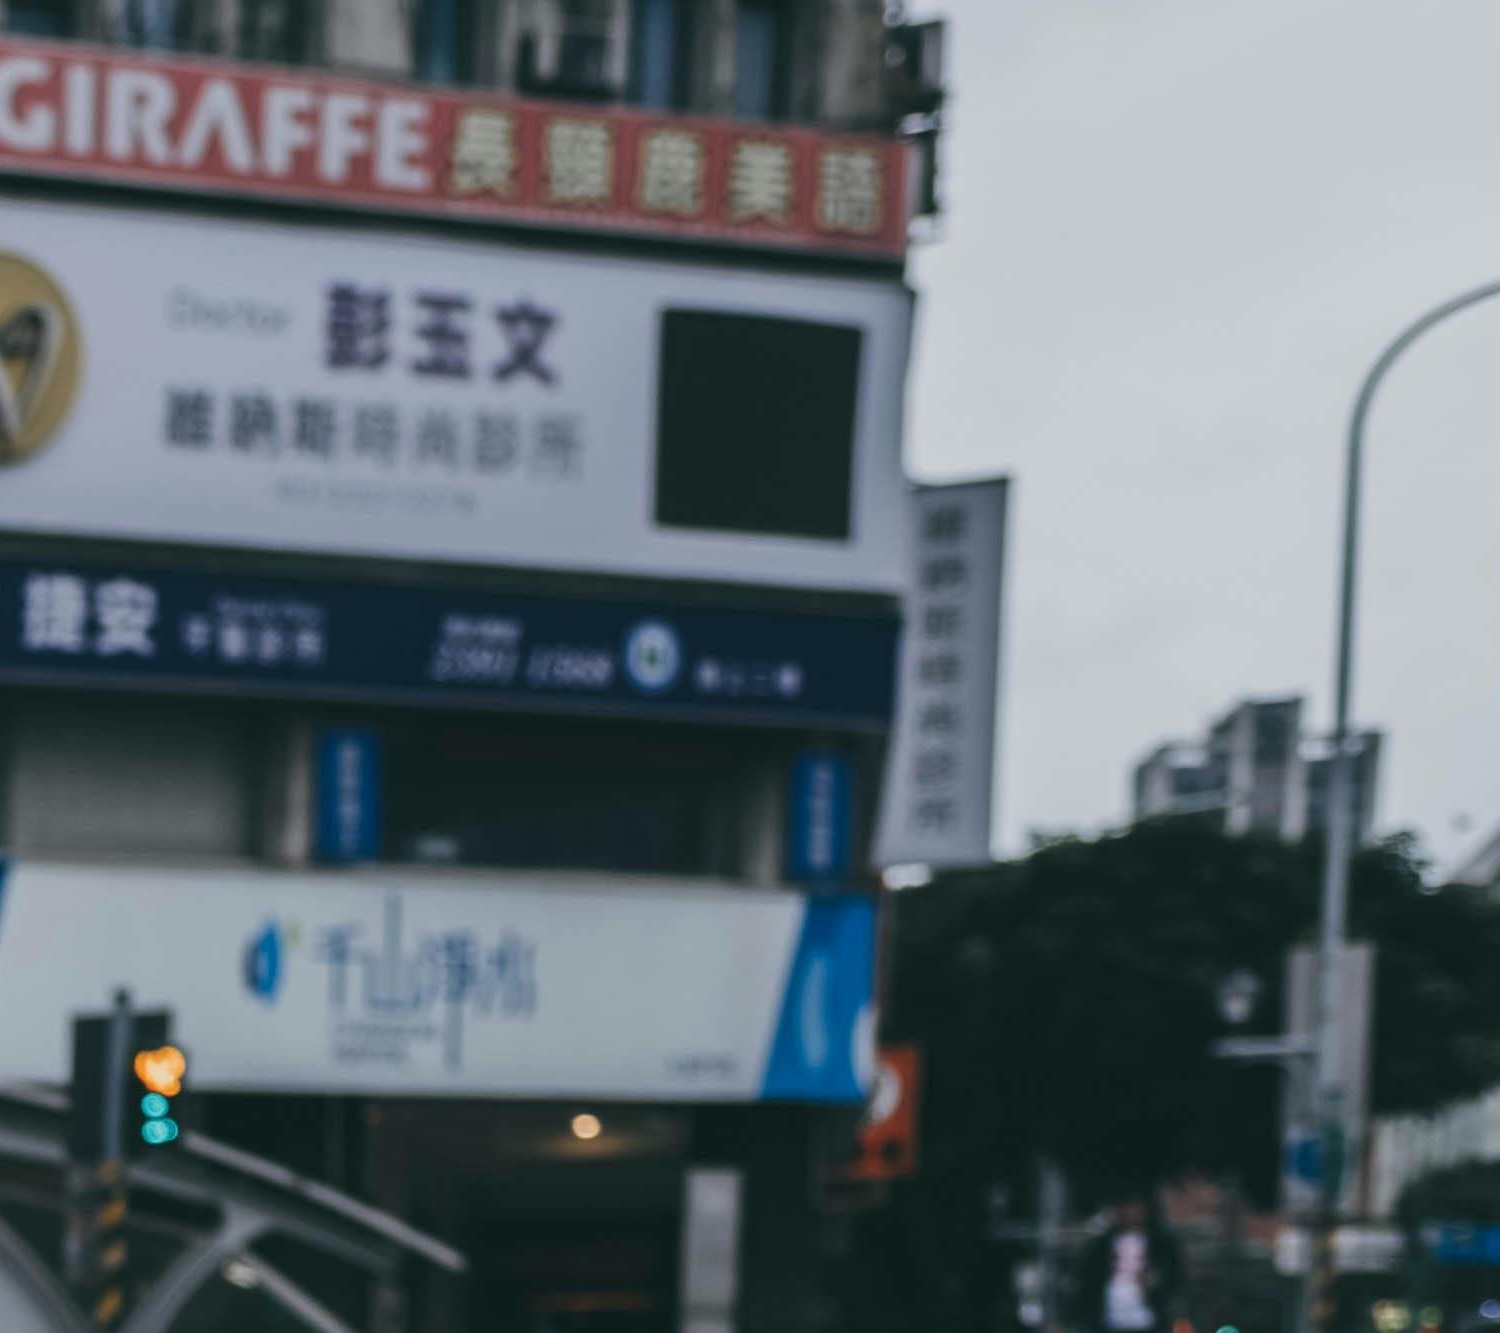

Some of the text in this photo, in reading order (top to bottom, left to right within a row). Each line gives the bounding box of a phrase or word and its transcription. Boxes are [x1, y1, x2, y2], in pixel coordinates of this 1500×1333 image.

[324, 282, 558, 386] 彭玉文
[317, 889, 537, 1069] 千山淨水
